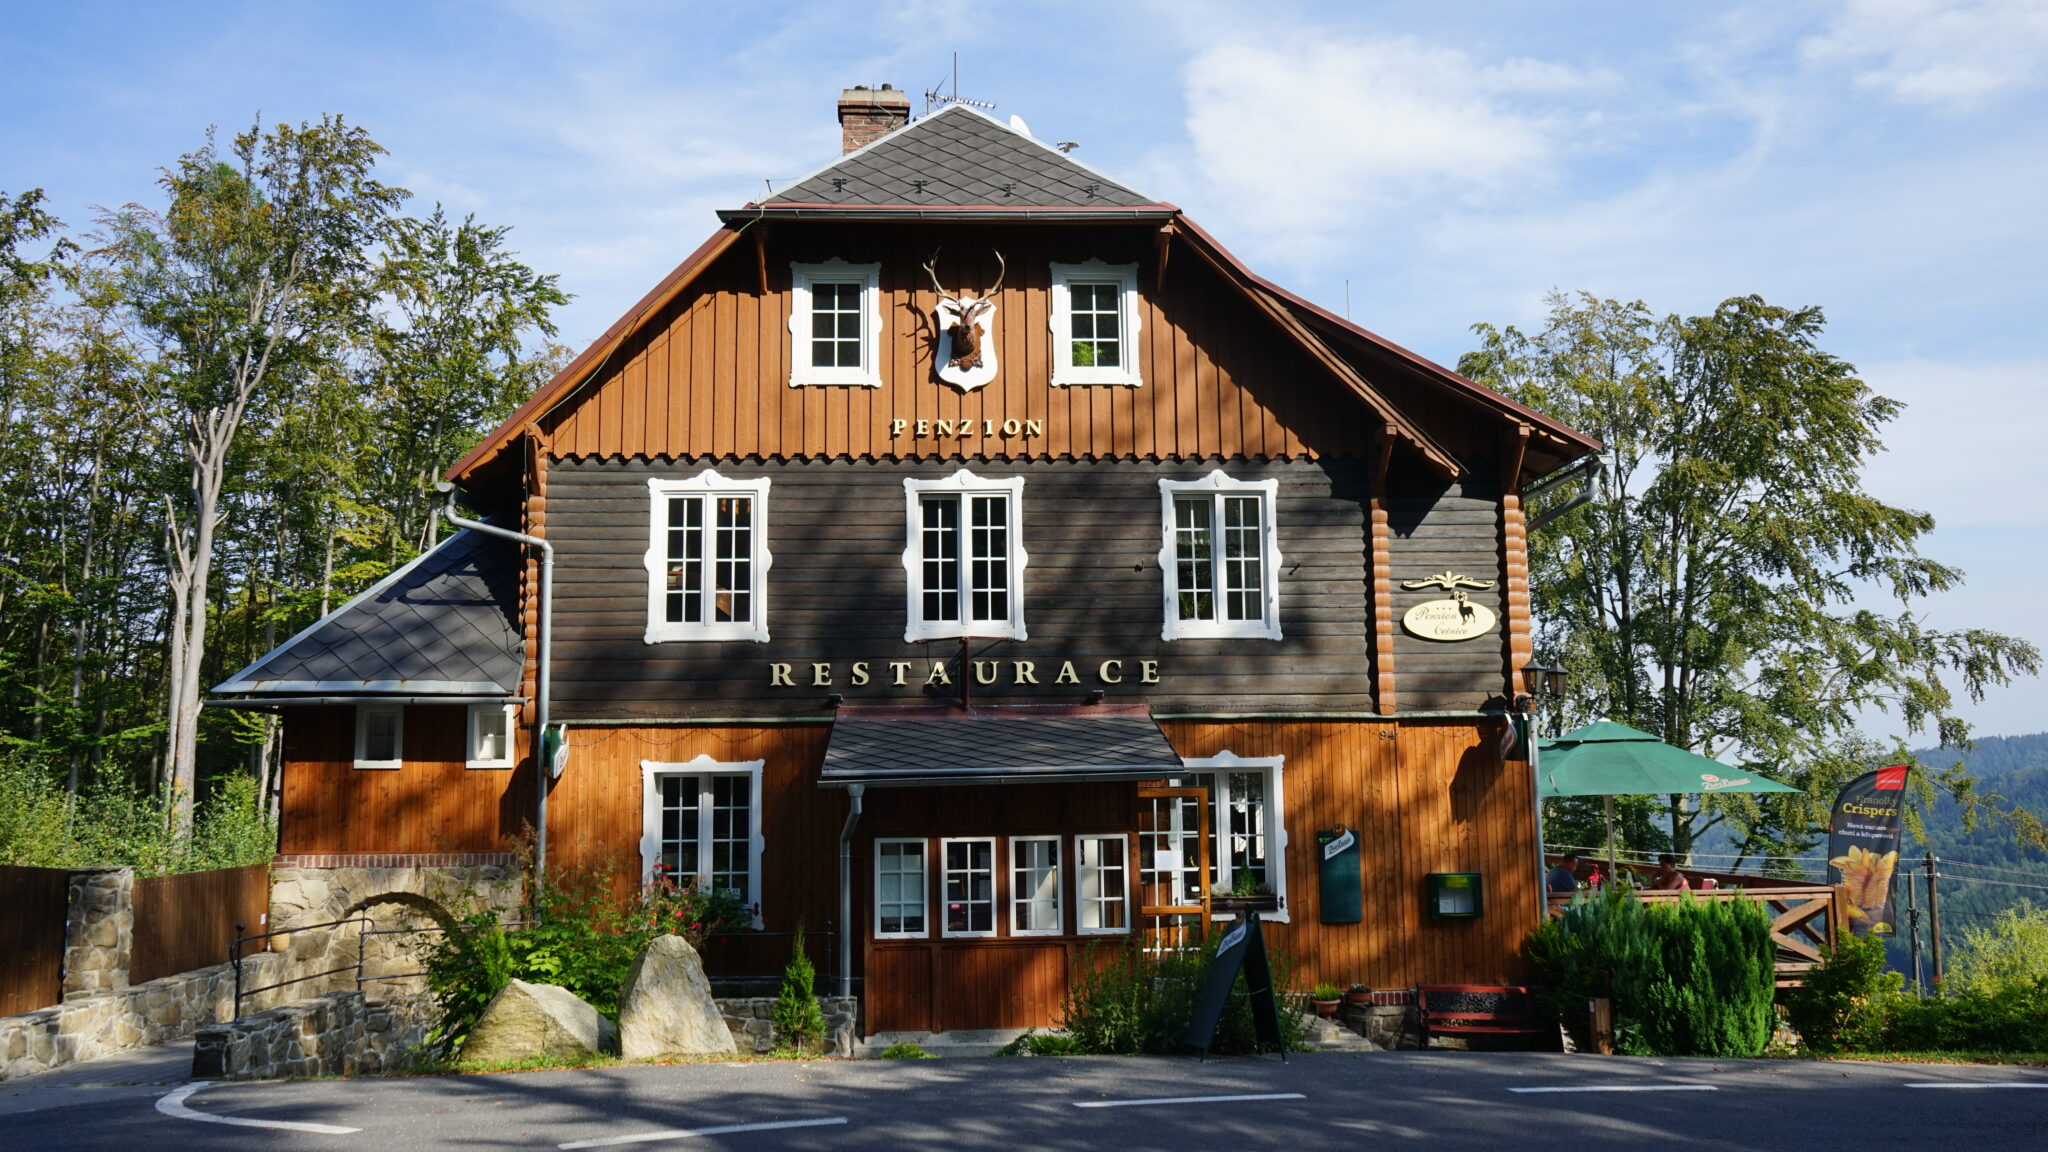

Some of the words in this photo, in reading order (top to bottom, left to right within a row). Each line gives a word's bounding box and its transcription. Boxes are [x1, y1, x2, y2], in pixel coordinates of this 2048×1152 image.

[892, 418, 1042, 435] PENZION
[769, 660, 1160, 687] RESTAURACE
[1842, 802, 1898, 819] Crispers
